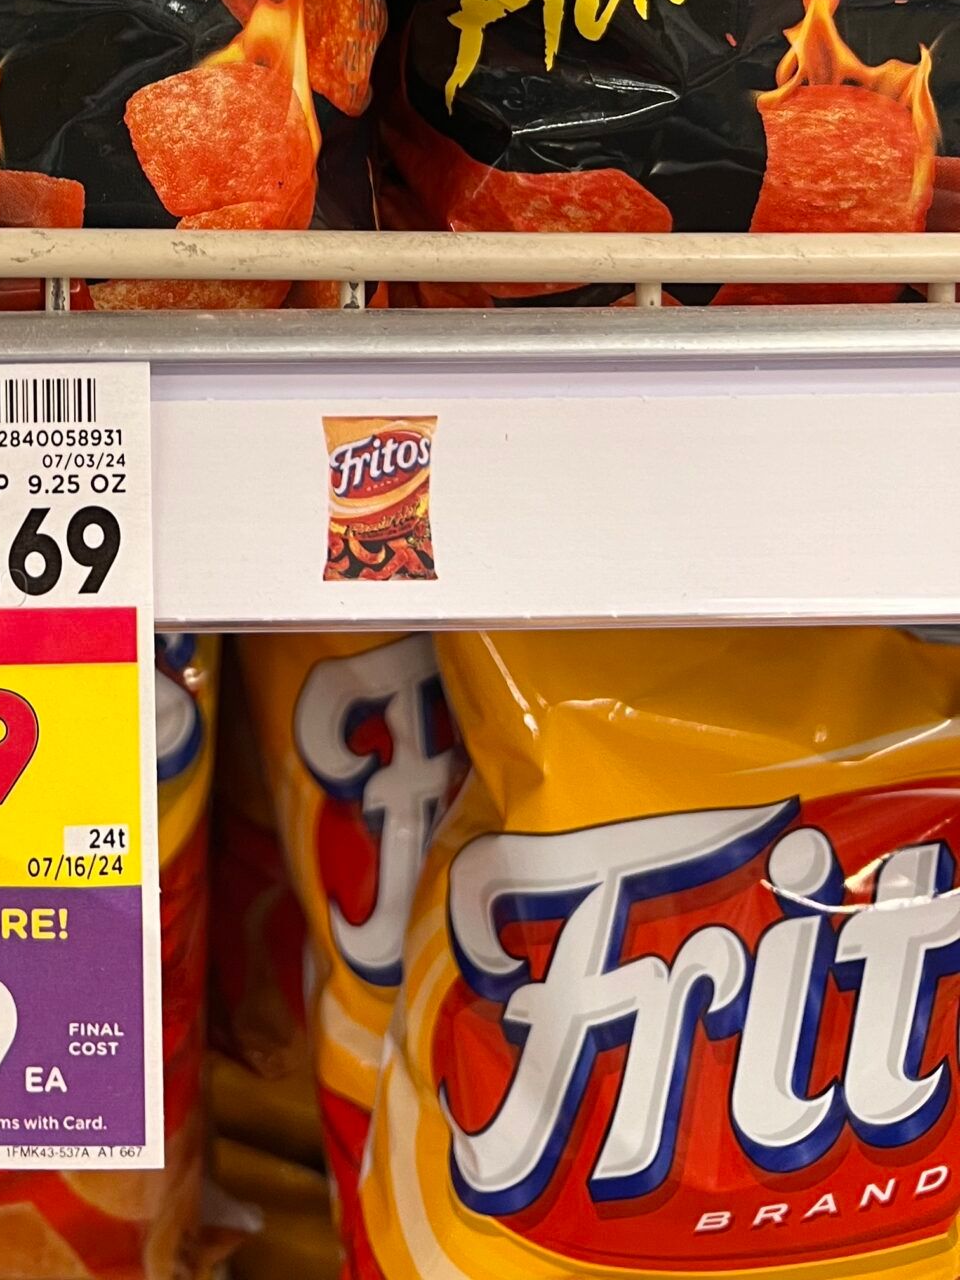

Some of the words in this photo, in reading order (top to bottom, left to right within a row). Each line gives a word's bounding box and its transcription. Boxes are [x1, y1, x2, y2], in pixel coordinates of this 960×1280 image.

[42, 452, 126, 471] 07/03/24
[329, 438, 431, 496] Fritos
[28, 474, 80, 494] 9.25
[91, 473, 126, 493] OZ
[89, 829, 126, 849] 24t
[27, 853, 123, 881] 07/16/24
[448, 800, 960, 1195] Frit
[68, 1023, 124, 1036] FINAL
[68, 1042, 119, 1056] COST
[25, 1067, 67, 1093] EA
[24, 1116, 59, 1130] with
[63, 1115, 108, 1131] Card.
[97, 1146, 114, 1158] AT
[119, 1146, 143, 1158] 667
[693, 1164, 949, 1233] BRAND
